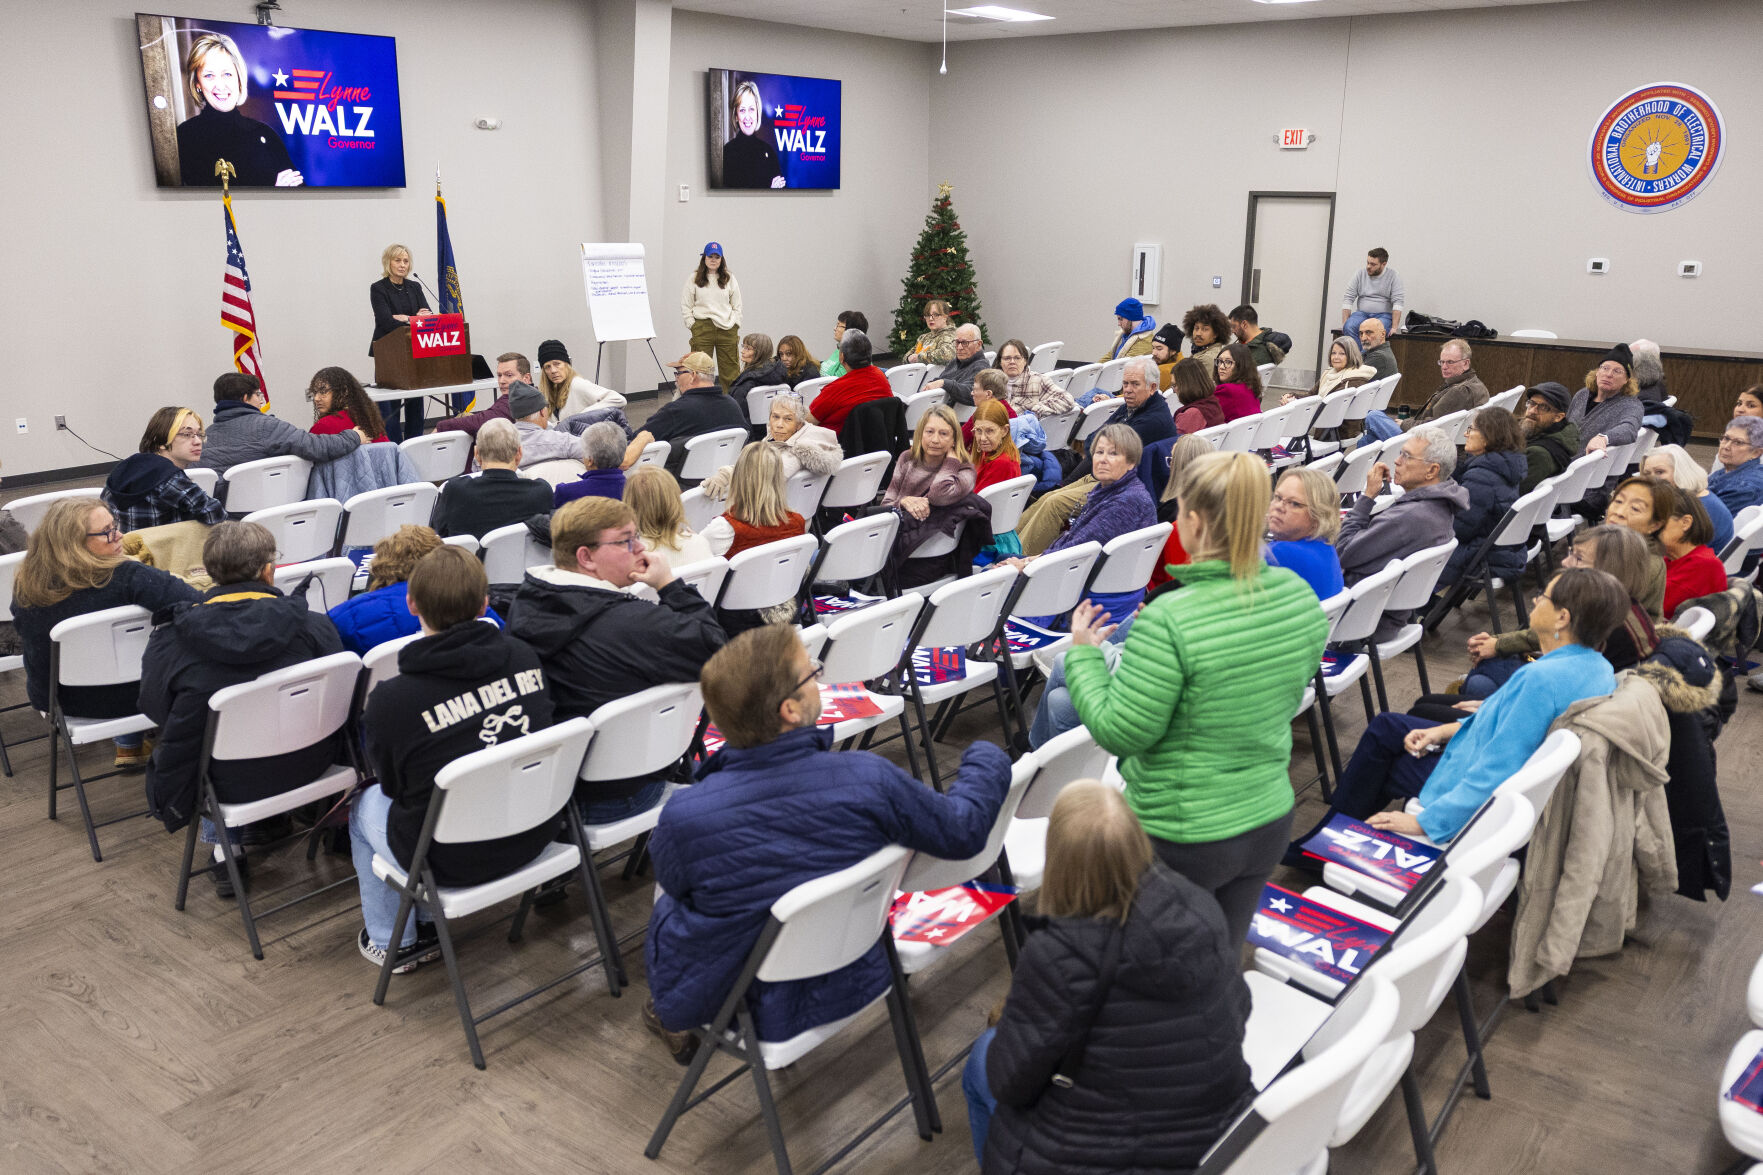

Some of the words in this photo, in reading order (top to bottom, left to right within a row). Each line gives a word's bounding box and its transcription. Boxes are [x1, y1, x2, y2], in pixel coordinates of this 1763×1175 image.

[319, 71, 371, 112] Lynne
[274, 102, 374, 137] WALZ
[798, 106, 825, 135] Lynne
[1612, 101, 1670, 138] BROTHERHOOD
[1673, 104, 1687, 117] OF
[328, 137, 375, 149] Governor
[774, 128, 826, 153] WALZ
[1284, 130, 1304, 145] EXIT
[1620, 115, 1651, 147] ORGANIZED
[1682, 130, 1690, 145] 1891
[1684, 114, 1703, 161] ELECTRICAL
[800, 153, 825, 161] Governor
[1607, 142, 1646, 192] INTERNATIONAL
[1653, 164, 1694, 192] WORKERS
[417, 331, 461, 348] WALZ
[421, 691, 482, 733] LANA
[477, 678, 517, 710] DEL
[514, 668, 544, 696] REY
[1348, 824, 1412, 850] Governor
